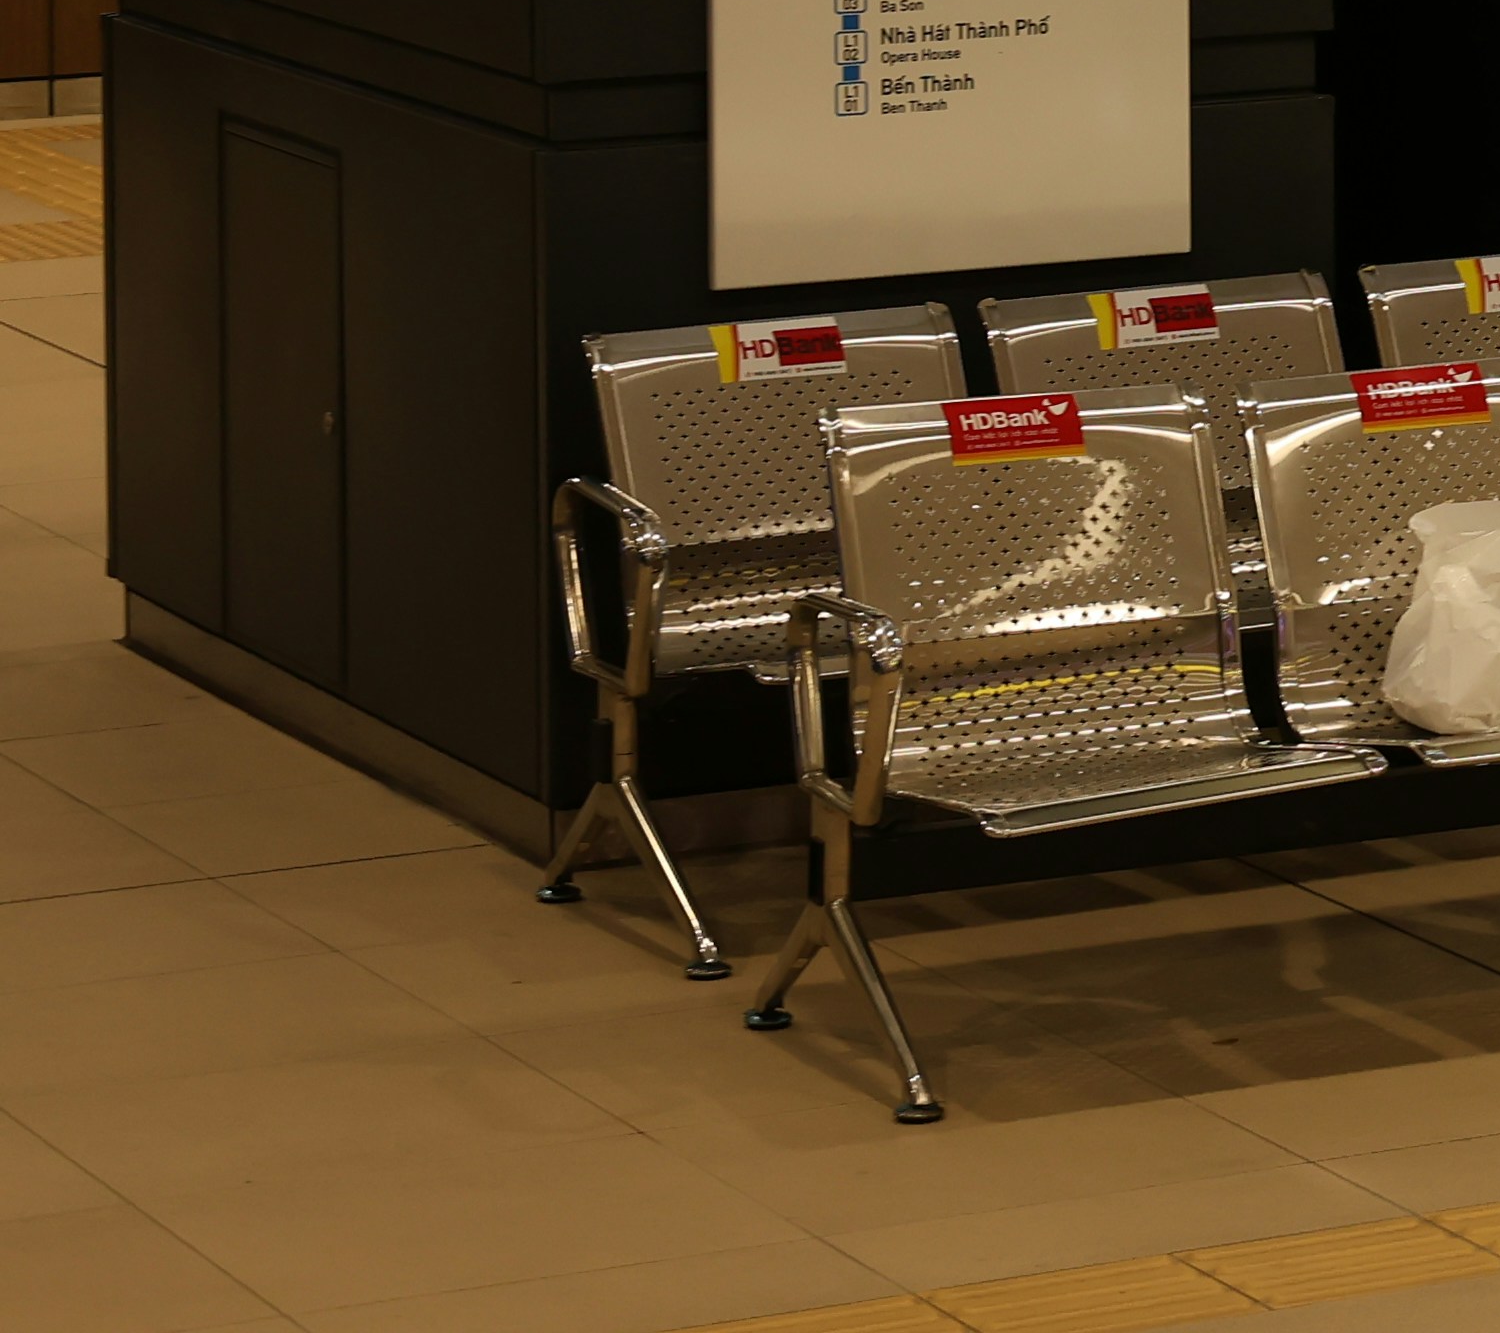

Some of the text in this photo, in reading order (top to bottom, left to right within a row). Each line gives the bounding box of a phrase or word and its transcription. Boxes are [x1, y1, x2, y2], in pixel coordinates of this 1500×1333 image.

[880, 0, 924, 13] Ba Son
[880, 15, 1050, 45] Nhà Hát Thành Phố
[881, 48, 960, 64] Opera House
[881, 74, 974, 96] Bến Thành
[881, 100, 947, 115] Ben Thanh
[1120, 298, 1214, 328] HDBank
[741, 331, 842, 360] HDBank
[960, 408, 1049, 432] HDBank
